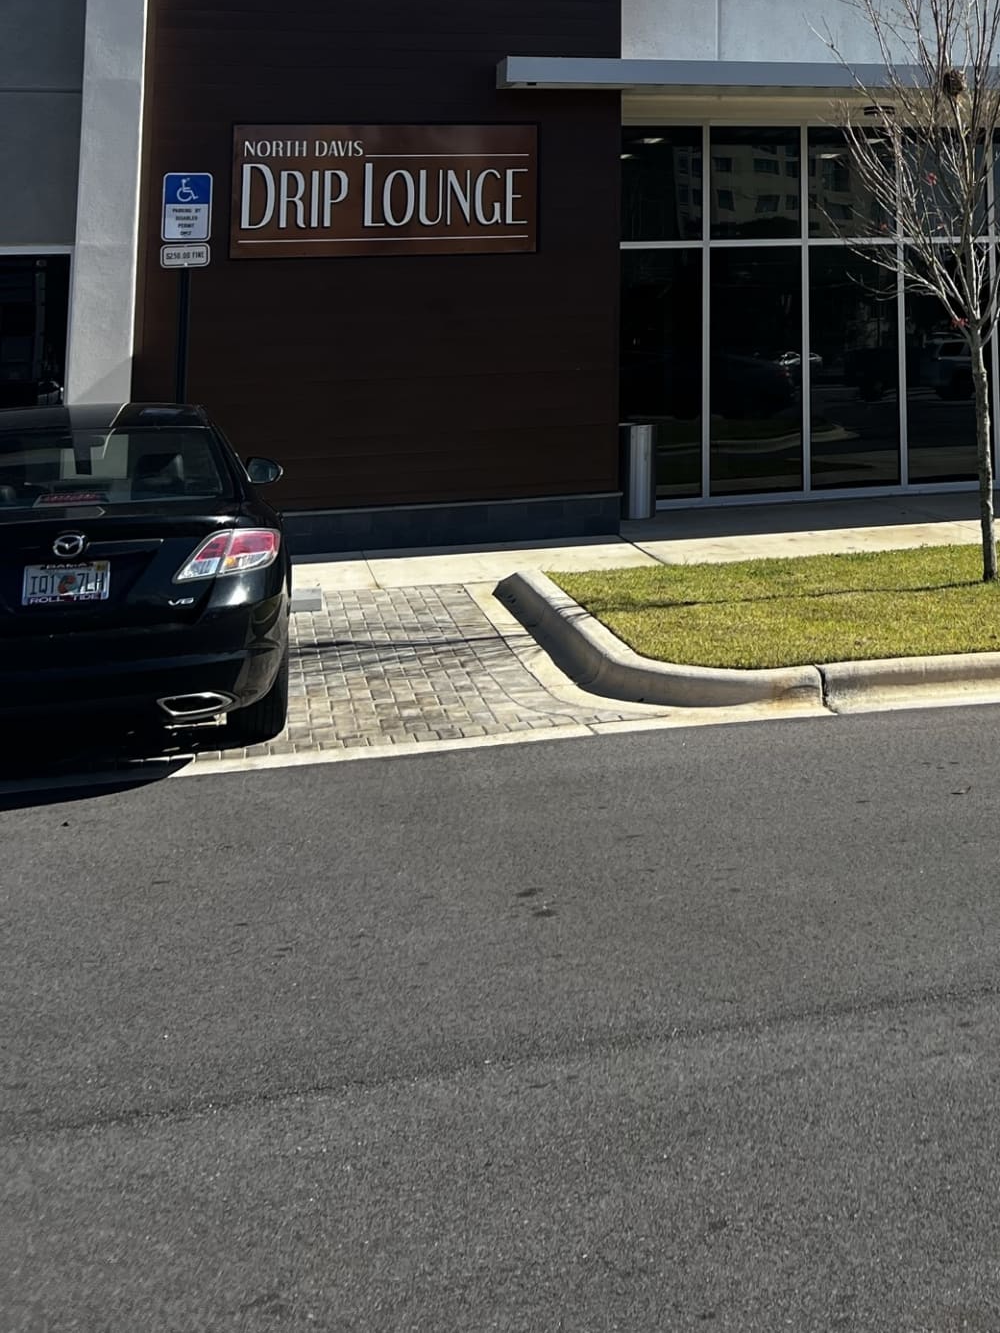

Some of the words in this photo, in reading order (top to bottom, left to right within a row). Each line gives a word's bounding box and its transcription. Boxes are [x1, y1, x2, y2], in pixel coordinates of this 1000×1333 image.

[243, 140, 308, 158] NORTH
[314, 140, 364, 157] DAVIS
[240, 163, 350, 230] DRIP
[362, 162, 529, 228] LOUNGE
[192, 251, 205, 259] FINE
[29, 596, 64, 604] ROLL
[168, 597, 194, 606] V6
